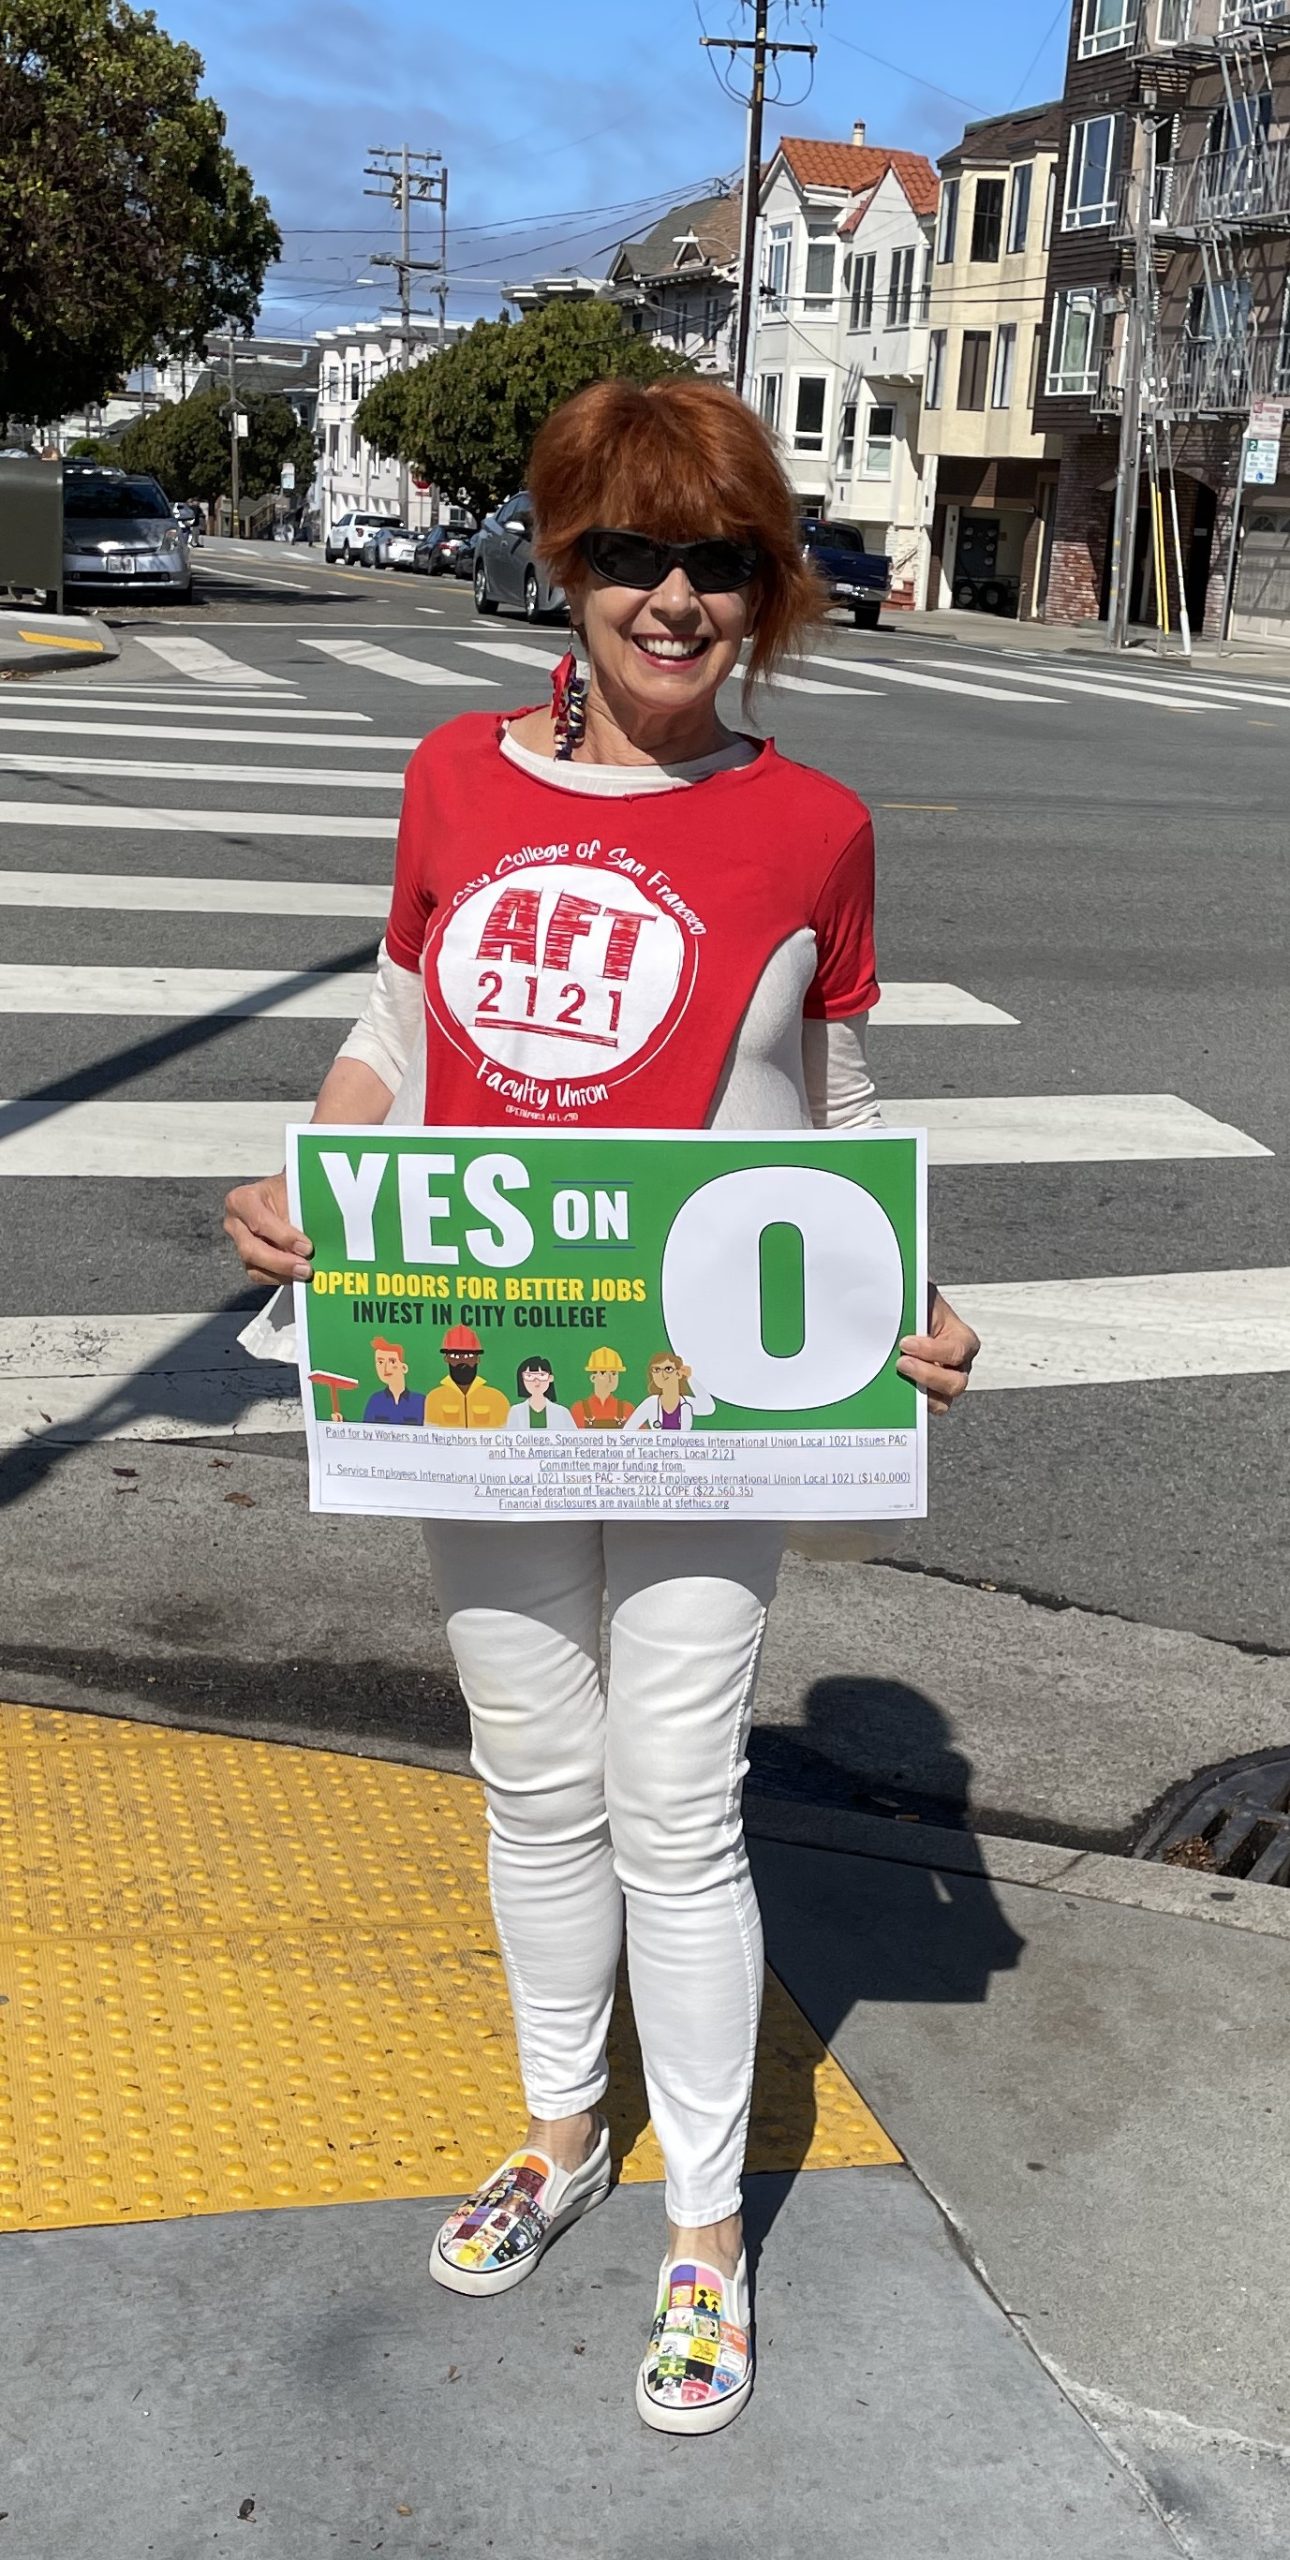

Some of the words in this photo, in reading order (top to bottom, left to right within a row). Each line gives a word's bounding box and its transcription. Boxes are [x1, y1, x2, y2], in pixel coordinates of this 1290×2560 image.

[453, 872, 491, 907] City
[495, 842, 569, 875] College
[576, 839, 601, 860] of
[604, 848, 646, 877] San
[474, 888, 658, 981] AFT
[476, 970, 622, 1032] 2121
[476, 1058, 549, 1110] Faculty
[556, 1083, 609, 1108] Union
[317, 1151, 535, 1268] YES
[552, 1189, 630, 1241] ON
[312, 1271, 369, 1295] OPEN
[376, 1273, 450, 1298] DOORS
[456, 1276, 498, 1300] FOR
[505, 1278, 585, 1301] BETTER
[591, 1279, 647, 1302] JOBS
[353, 1301, 424, 1325] INVEST
[432, 1303, 452, 1325] IN
[460, 1304, 506, 1327] CITY
[514, 1305, 607, 1328] COLLEGE
[326, 1427, 345, 1438] Paid
[348, 1428, 360, 1439] for
[363, 1428, 373, 1440] by
[375, 1429, 410, 1441] Workers
[412, 1432, 429, 1443] and
[432, 1433, 477, 1446] Neighbors
[480, 1435, 492, 1445] for
[495, 1435, 513, 1446] City
[555, 1435, 602, 1446] Sponsored
[607, 1435, 617, 1446] by
[619, 1435, 653, 1446] Service
[656, 1436, 704, 1447] Employees
[708, 1436, 767, 1447] International
[771, 1436, 798, 1447] Union
[801, 1436, 825, 1447] Local
[829, 1435, 851, 1446] 1021
[856, 1435, 885, 1446] Issues
[888, 1434, 907, 1445] PAC
[489, 1448, 506, 1459] and
[509, 1448, 525, 1459] The
[528, 1448, 572, 1459] American
[575, 1448, 623, 1459] Federation
[627, 1448, 635, 1459] of
[685, 1448, 708, 1459] Local
[712, 1448, 735, 1459] 2121
[539, 1460, 590, 1471] Committee
[593, 1460, 619, 1471] major
[622, 1460, 658, 1471] funding
[337, 1464, 368, 1477] Service
[371, 1466, 417, 1480] Employees
[420, 1469, 476, 1483] International
[480, 1473, 506, 1484] Union
[509, 1473, 533, 1484] Local
[538, 1473, 559, 1484] 1021
[563, 1473, 592, 1484] Issues
[595, 1473, 613, 1484] PAC
[624, 1473, 656, 1484] Service
[660, 1473, 708, 1484] Employees
[712, 1473, 770, 1484] International
[774, 1473, 800, 1484] Union
[804, 1473, 828, 1484] Local
[832, 1473, 854, 1484] 1021
[485, 1486, 529, 1497] American
[532, 1486, 580, 1497] Federation
[583, 1486, 592, 1497] of
[595, 1486, 635, 1497] Teachers
[639, 1486, 661, 1497] 2121
[665, 1486, 688, 1497] COPE
[500, 1499, 541, 1509] Financial
[544, 1499, 596, 1509] disclosures
[600, 1499, 614, 1509] are
[617, 1499, 659, 1509] available
[663, 1499, 672, 1509] at
